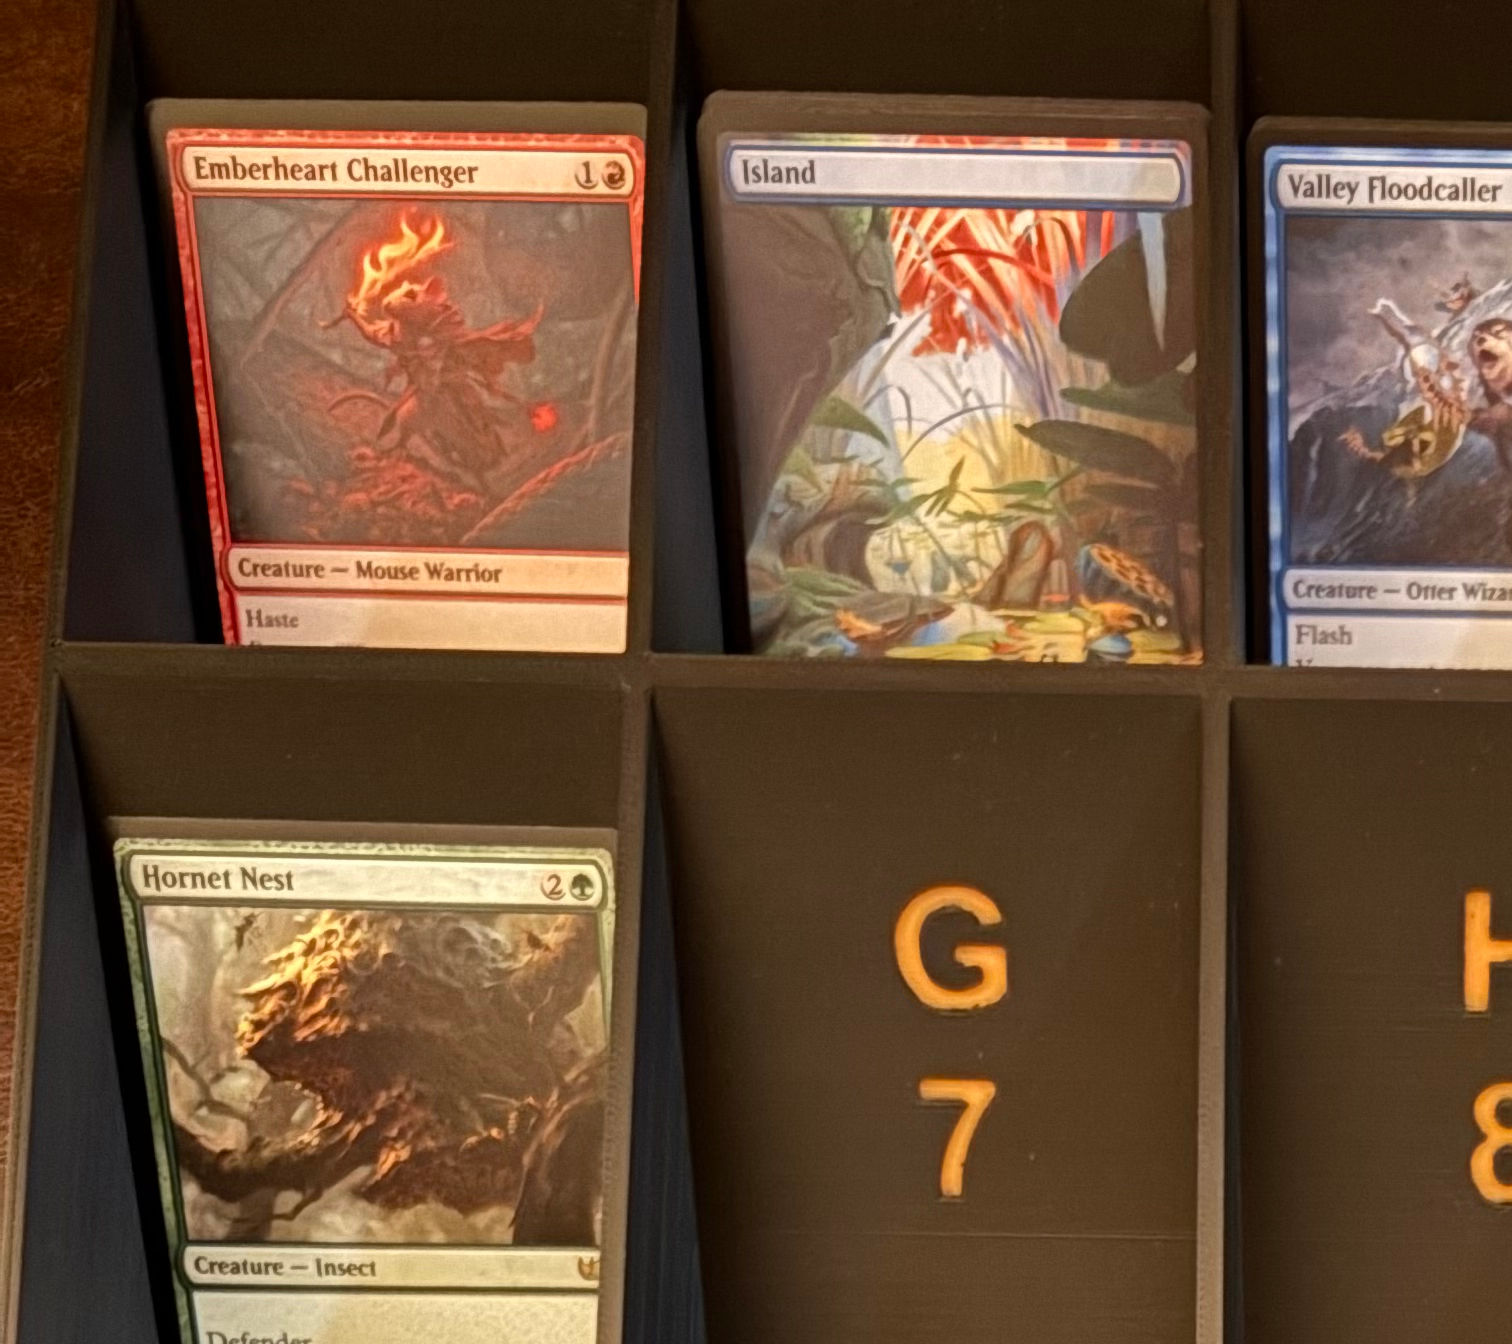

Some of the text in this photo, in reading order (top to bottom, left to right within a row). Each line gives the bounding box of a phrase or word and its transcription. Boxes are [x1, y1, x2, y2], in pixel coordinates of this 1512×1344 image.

[193, 156, 479, 189] Emberheart Challenger
[741, 158, 816, 185] Island
[1287, 174, 1503, 204] Valley Floodcaller
[237, 558, 325, 580] Creature
[355, 560, 420, 580] Mouse
[423, 562, 502, 583] Warrior
[1292, 580, 1377, 600] Creature
[1406, 582, 1455, 600] Otter
[245, 609, 299, 628] Haste
[1295, 624, 1353, 646] Flash
[142, 864, 295, 892] Hornet Nest
[893, 885, 1009, 1011] G
[917, 1076, 998, 1198] 7
[195, 1257, 283, 1276] Creature
[315, 1258, 377, 1277] Insect
